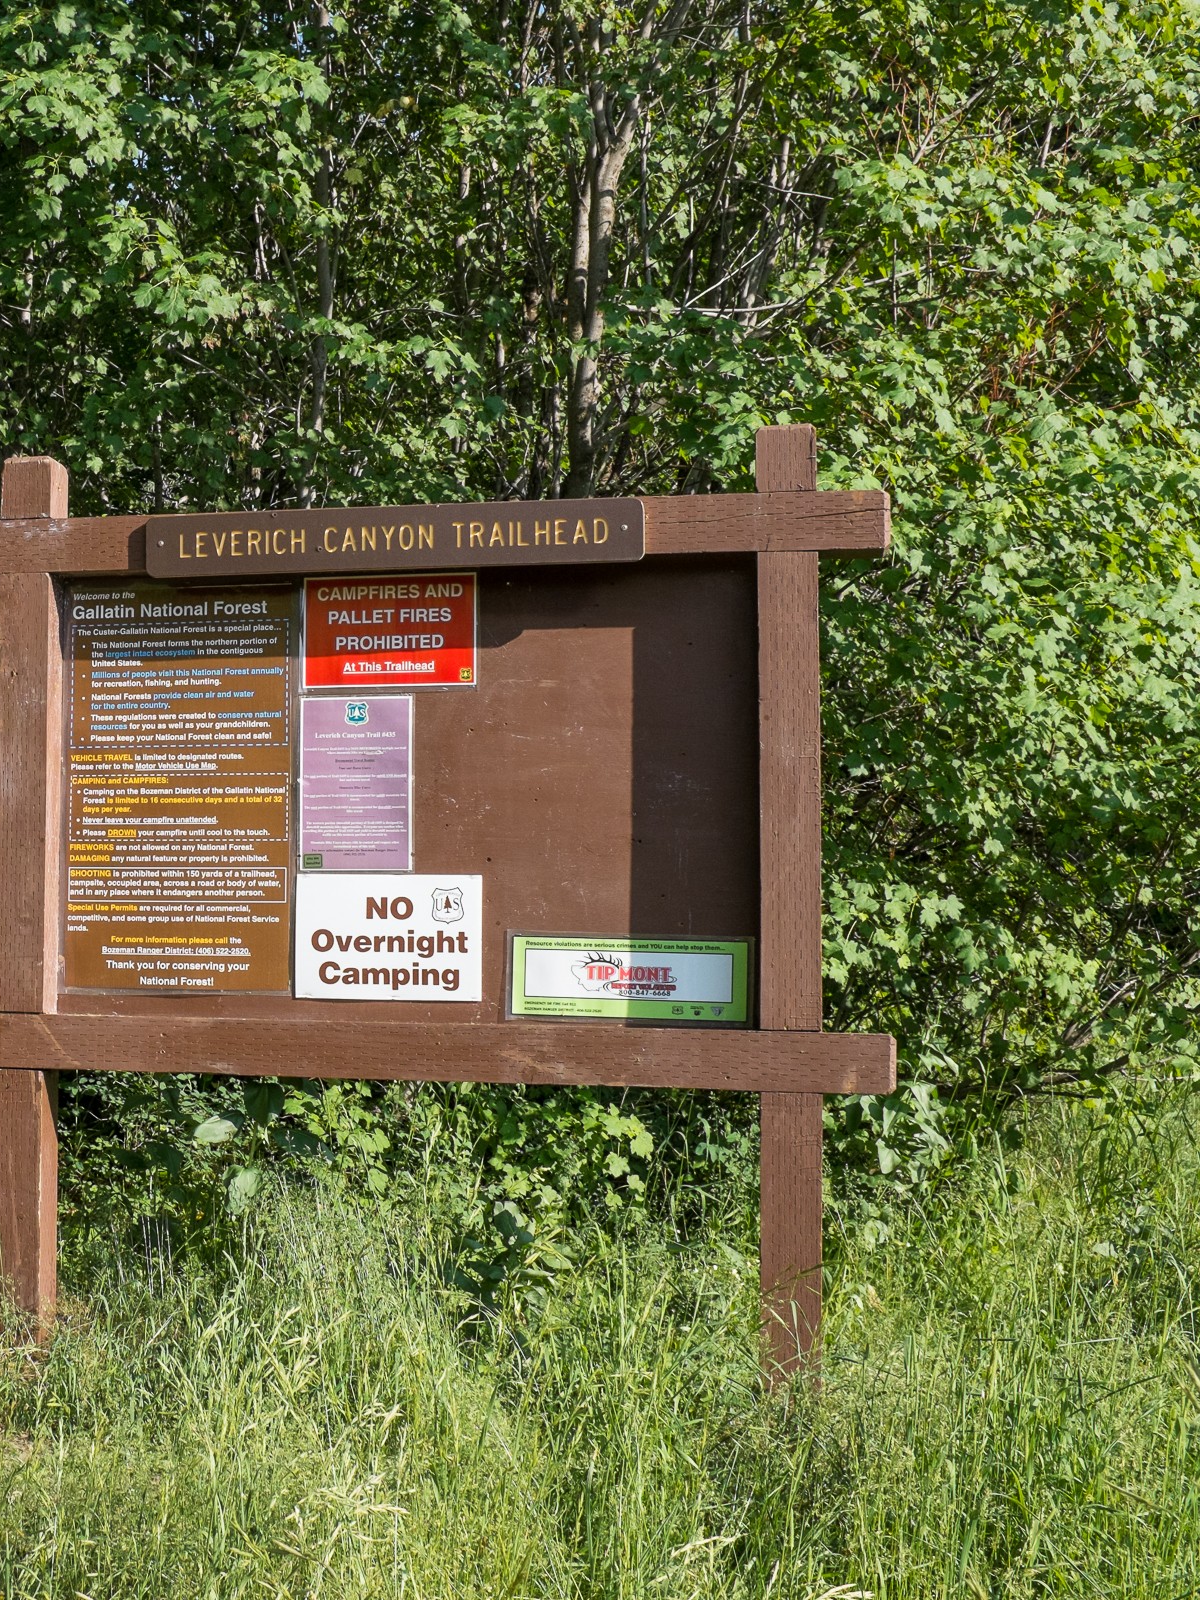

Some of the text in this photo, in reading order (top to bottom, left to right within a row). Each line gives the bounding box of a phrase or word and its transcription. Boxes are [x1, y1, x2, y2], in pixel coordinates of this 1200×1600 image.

[179, 518, 609, 559] LEVERICH CANYON TRAILHEAD
[318, 584, 462, 601] CAMPFIRES AND
[73, 601, 267, 620] Gallatin National Forest
[329, 608, 451, 624] PALLET FIRES
[93, 627, 148, 636] Custer-Gallatin
[224, 625, 251, 633] special
[253, 624, 281, 632] place...
[240, 638, 267, 646] portion
[336, 634, 444, 650] PROHIBITED
[106, 651, 131, 659] largest
[155, 649, 195, 657] ecosystem
[220, 647, 263, 655] contiguous
[343, 661, 434, 672] At This Trailhead
[132, 671, 156, 679] people
[251, 667, 283, 675] annually
[104, 679, 143, 688] recreation,
[145, 679, 173, 687] fishing,
[190, 678, 221, 687] hunting.
[154, 692, 181, 700] provide
[177, 753, 216, 761] designated
[189, 855, 219, 864] property
[230, 855, 269, 863] prohibited.
[366, 897, 413, 920] NO
[189, 937, 213, 945] please
[311, 929, 468, 958] Overnight
[106, 961, 249, 972] Thank you for conserving your
[587, 965, 672, 980] TIP MONT
[140, 977, 214, 986] National Forest!
[319, 961, 459, 991] Camping
